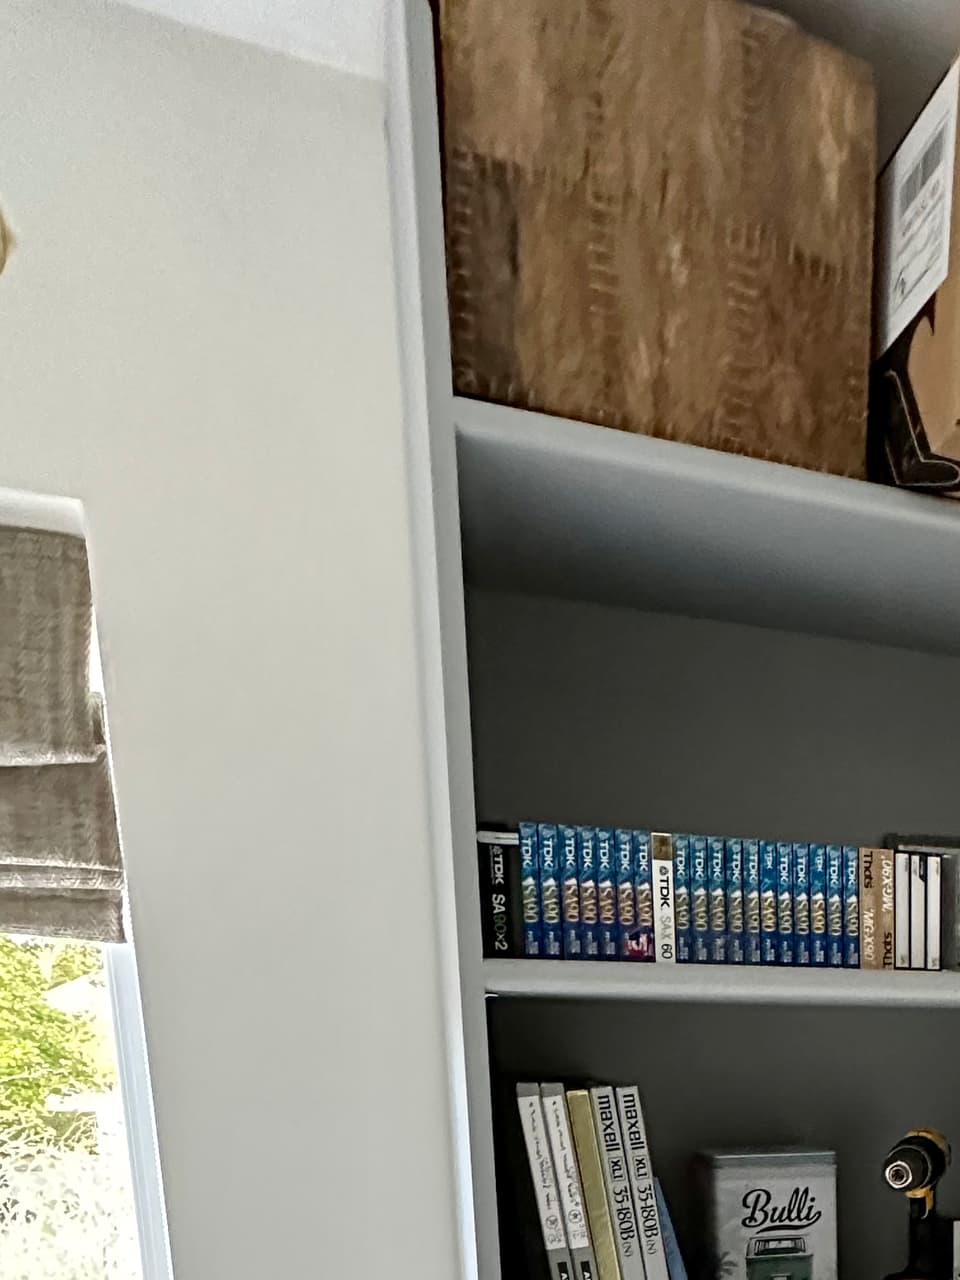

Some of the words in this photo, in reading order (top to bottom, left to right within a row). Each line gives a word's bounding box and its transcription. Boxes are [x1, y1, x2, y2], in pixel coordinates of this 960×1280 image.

[521, 837, 532, 866] TDK
[544, 838, 553, 867] TDK
[565, 838, 574, 866] TDK
[582, 840, 592, 868] TDK
[600, 840, 610, 868] TDK
[620, 842, 630, 870] TDK
[638, 844, 648, 872] TDK
[676, 848, 686, 876] TDK
[694, 850, 704, 878] TDK
[712, 850, 722, 878] TDK
[494, 852, 505, 885] TDK
[732, 852, 742, 880] TDK
[748, 854, 758, 881] TDK
[780, 856, 790, 882] TDK
[796, 856, 806, 882] TDK
[830, 858, 838, 885] TDK
[848, 860, 856, 886] TDK
[660, 876, 669, 908] TDK
[662, 944, 672, 959] 60
[597, 1094, 621, 1153] maxell
[622, 1093, 646, 1151] maxell
[742, 1186, 822, 1234] Bulli
